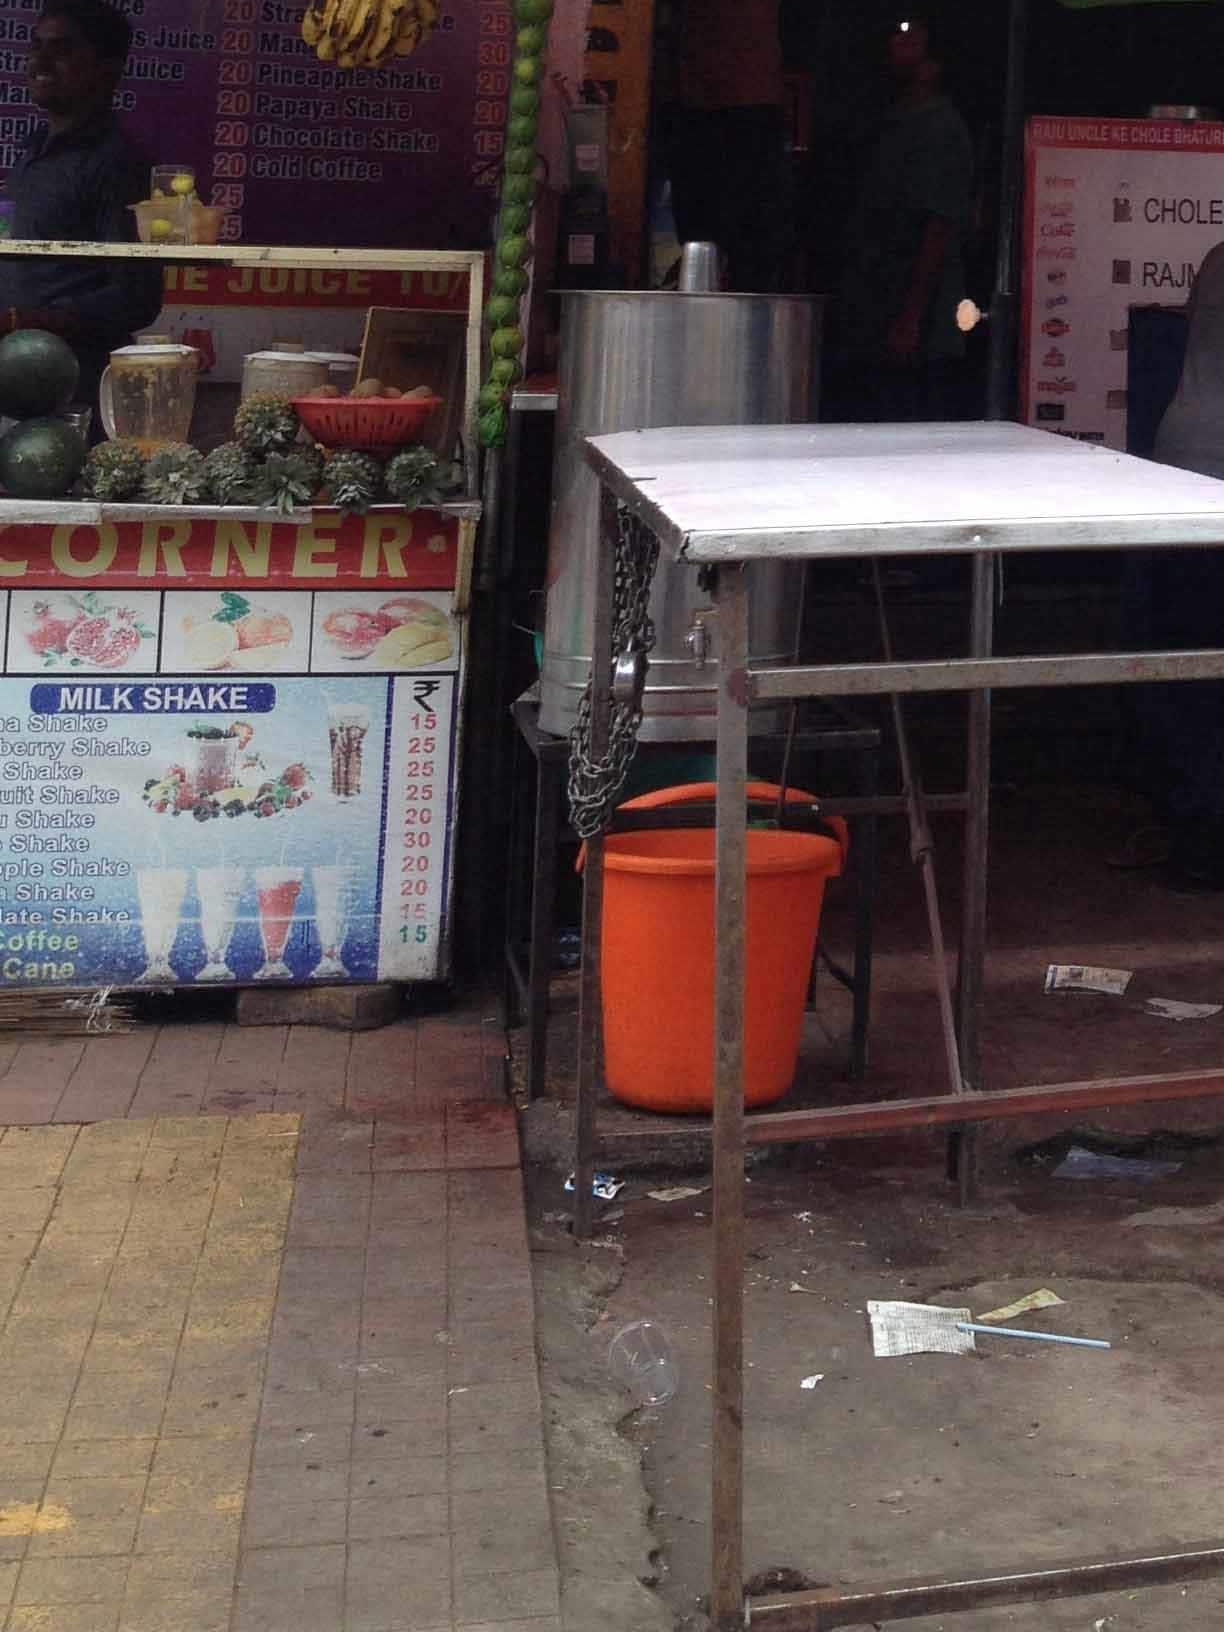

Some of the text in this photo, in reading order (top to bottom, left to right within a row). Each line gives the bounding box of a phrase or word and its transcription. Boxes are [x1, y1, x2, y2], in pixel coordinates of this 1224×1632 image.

[153, 29, 216, 50] Juice
[220, 61, 251, 81] 20
[256, 64, 369, 90] Pineapple
[375, 69, 441, 91] Shake
[218, 93, 250, 113] 20
[255, 96, 336, 119] Papaya
[345, 98, 411, 120] Shake
[216, 123, 248, 145] 20
[252, 125, 366, 150] Chocolate
[372, 129, 439, 152] Shake
[214, 153, 247, 175] 20
[251, 156, 383, 181] Cold Coffee
[212, 185, 243, 206] 25
[1144, 198, 1223, 225] CHOLE
[59, 687, 133, 711] MILK
[143, 687, 249, 711] SHAKE
[28, 714, 108, 733] Shake
[410, 714, 437, 730] 15
[72, 737, 151, 756] Shake
[408, 738, 435, 754] 25
[3, 761, 434, 780] Shake 25
[40, 786, 120, 804] Shake
[405, 785, 433, 801] 25
[16, 809, 431, 828] Shake 20
[10, 832, 431, 852] Shake 30
[51, 859, 130, 877] Shake
[402, 856, 429, 872] 20
[16, 880, 428, 902] Shake 20
[51, 908, 130, 925] Shake
[398, 926, 428, 943] 15
[4, 958, 76, 980] Cane
